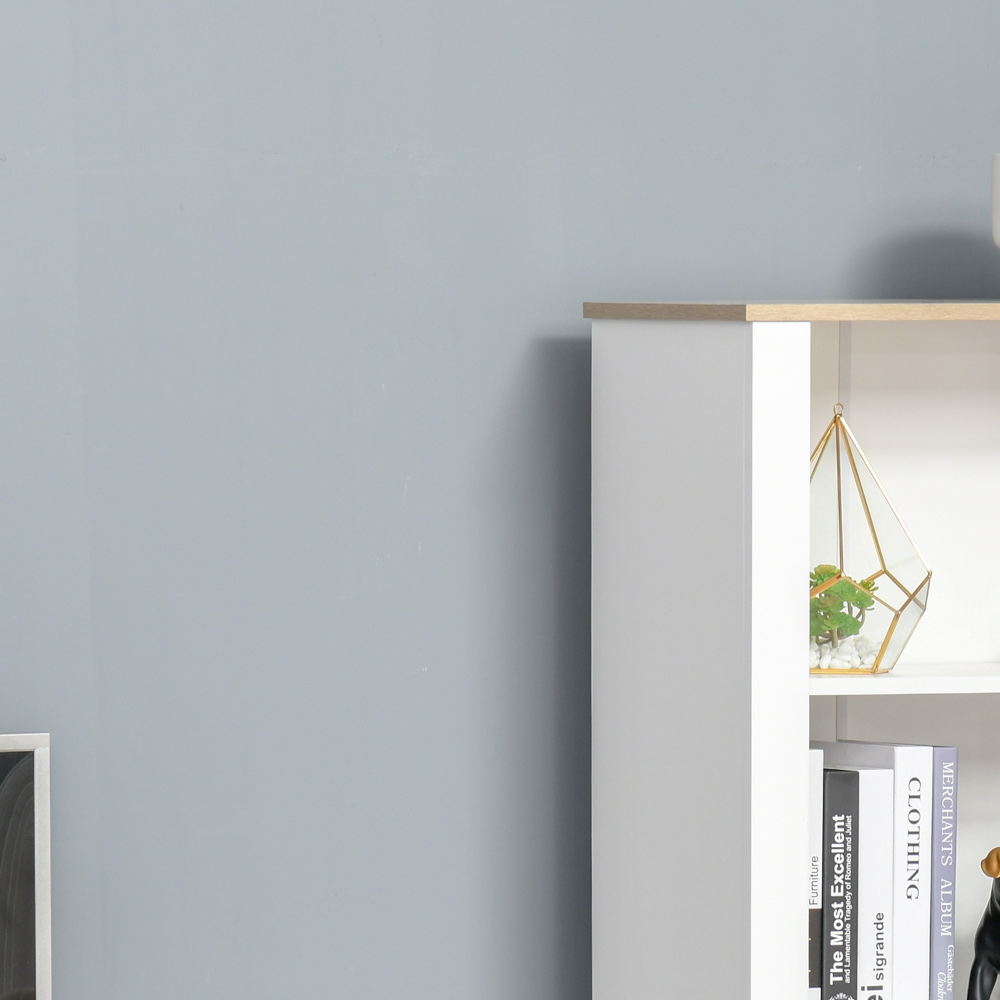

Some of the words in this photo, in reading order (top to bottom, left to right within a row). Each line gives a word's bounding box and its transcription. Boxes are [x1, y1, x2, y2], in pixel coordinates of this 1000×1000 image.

[906, 777, 922, 900] CLOTHING
[942, 761, 954, 866] MERCHANTS
[809, 856, 819, 905] Furniture
[831, 814, 844, 897] Excellent
[844, 891, 852, 922] Tragedy
[845, 882, 851, 890] of
[941, 878, 952, 937] ALBUM
[830, 901, 844, 946] Most
[873, 912, 887, 980] sigrande
[830, 951, 843, 985] The
